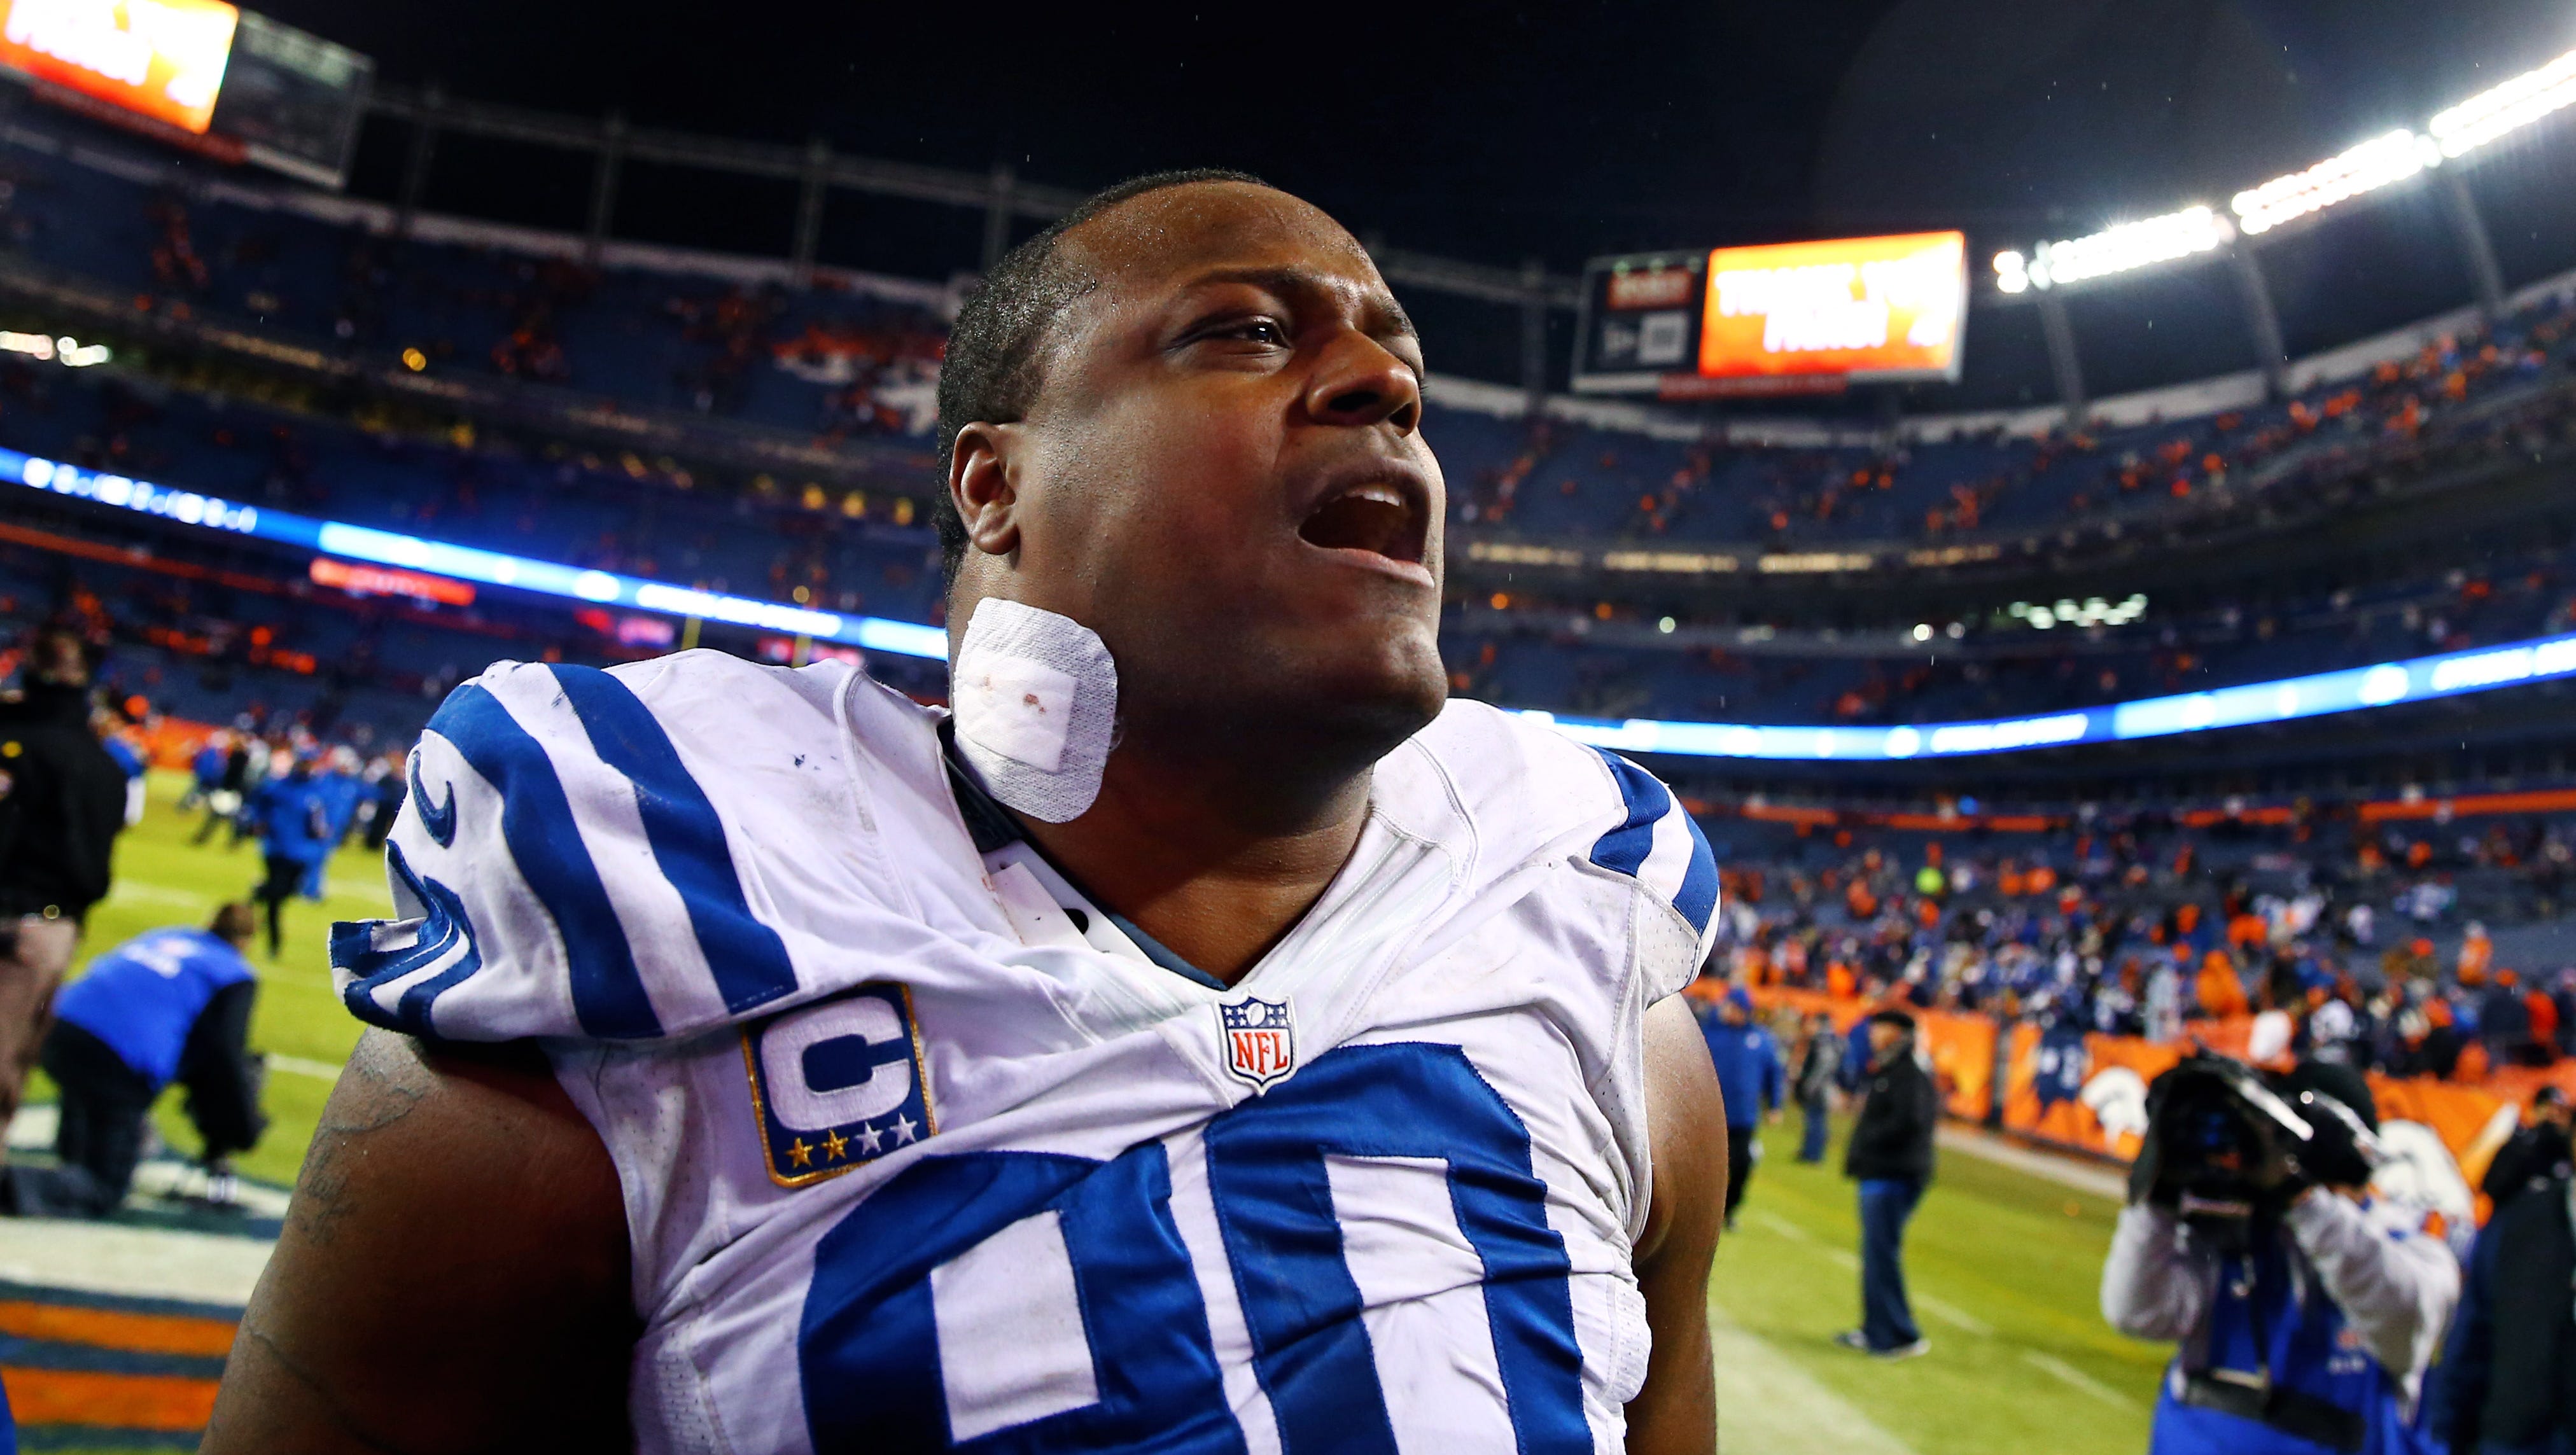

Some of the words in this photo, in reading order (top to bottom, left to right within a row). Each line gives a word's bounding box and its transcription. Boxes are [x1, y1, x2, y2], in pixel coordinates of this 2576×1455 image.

[760, 996, 911, 1131] C
[1233, 1032, 1287, 1075] NFL
[798, 1041, 1594, 1455] 90
